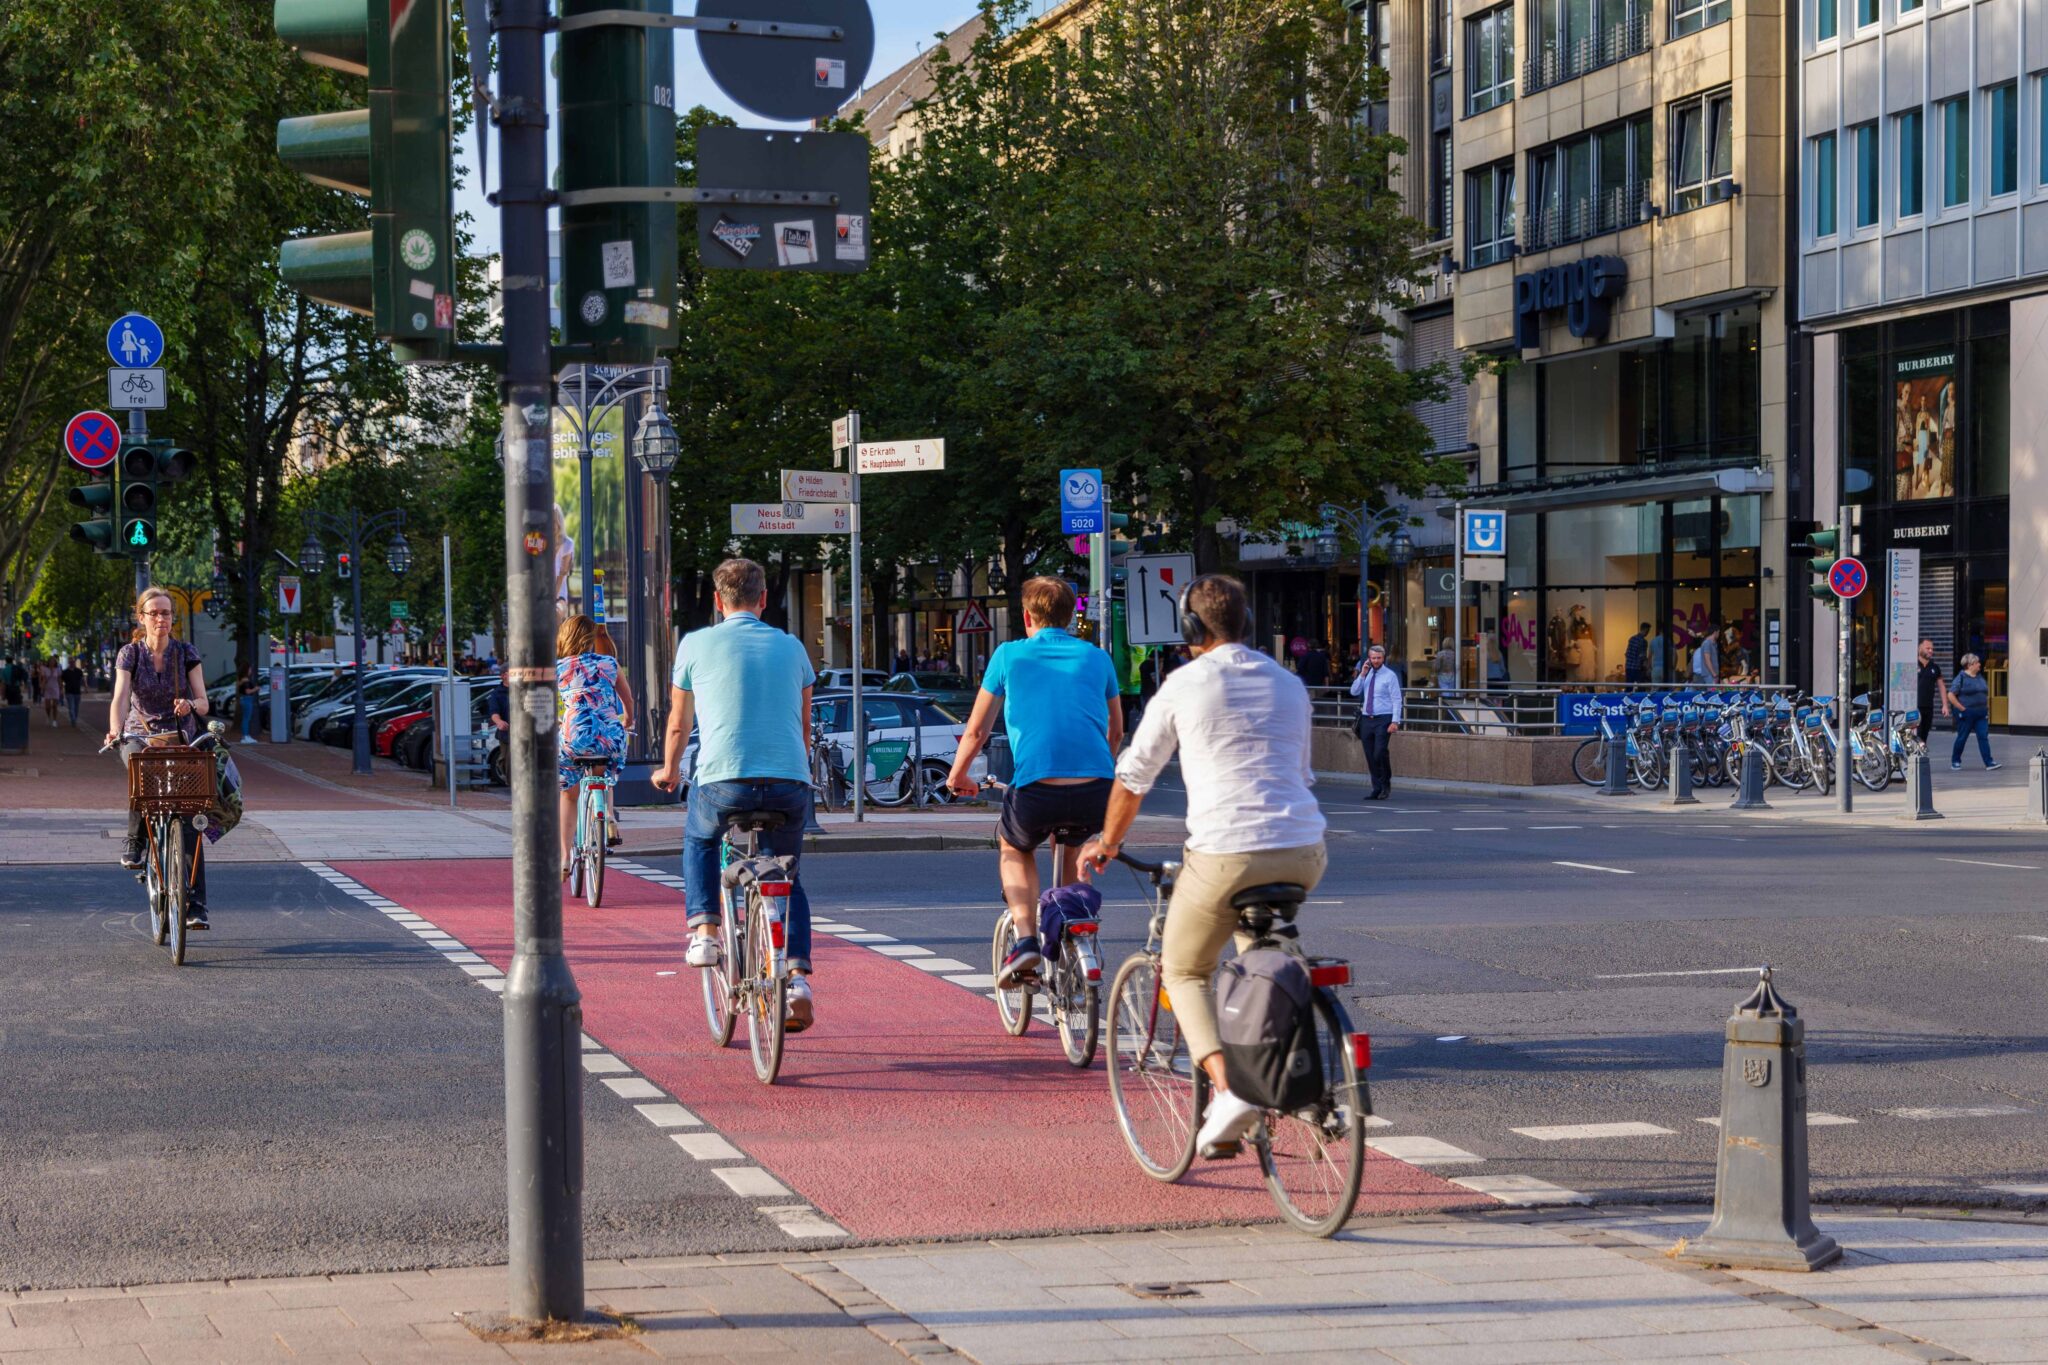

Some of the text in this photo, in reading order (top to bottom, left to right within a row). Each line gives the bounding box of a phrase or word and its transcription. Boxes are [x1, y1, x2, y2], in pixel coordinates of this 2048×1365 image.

[654, 85, 672, 108] 082
[1514, 255, 1612, 350] prange
[1898, 354, 1956, 373] BURBERRY
[129, 395, 147, 405] frei
[869, 445, 921, 457] Erkrath 12
[869, 459, 906, 470] Hauptbahnhof
[805, 477, 824, 486] Hilden
[798, 488, 838, 498] Friedrichstadt
[757, 508, 782, 518] Neus
[758, 521, 796, 530] Altstadt
[1071, 519, 1095, 528] 5020
[1893, 525, 1950, 539] BURBERRY
[1501, 613, 1536, 650] SALE
[1672, 603, 1756, 650] SAE
